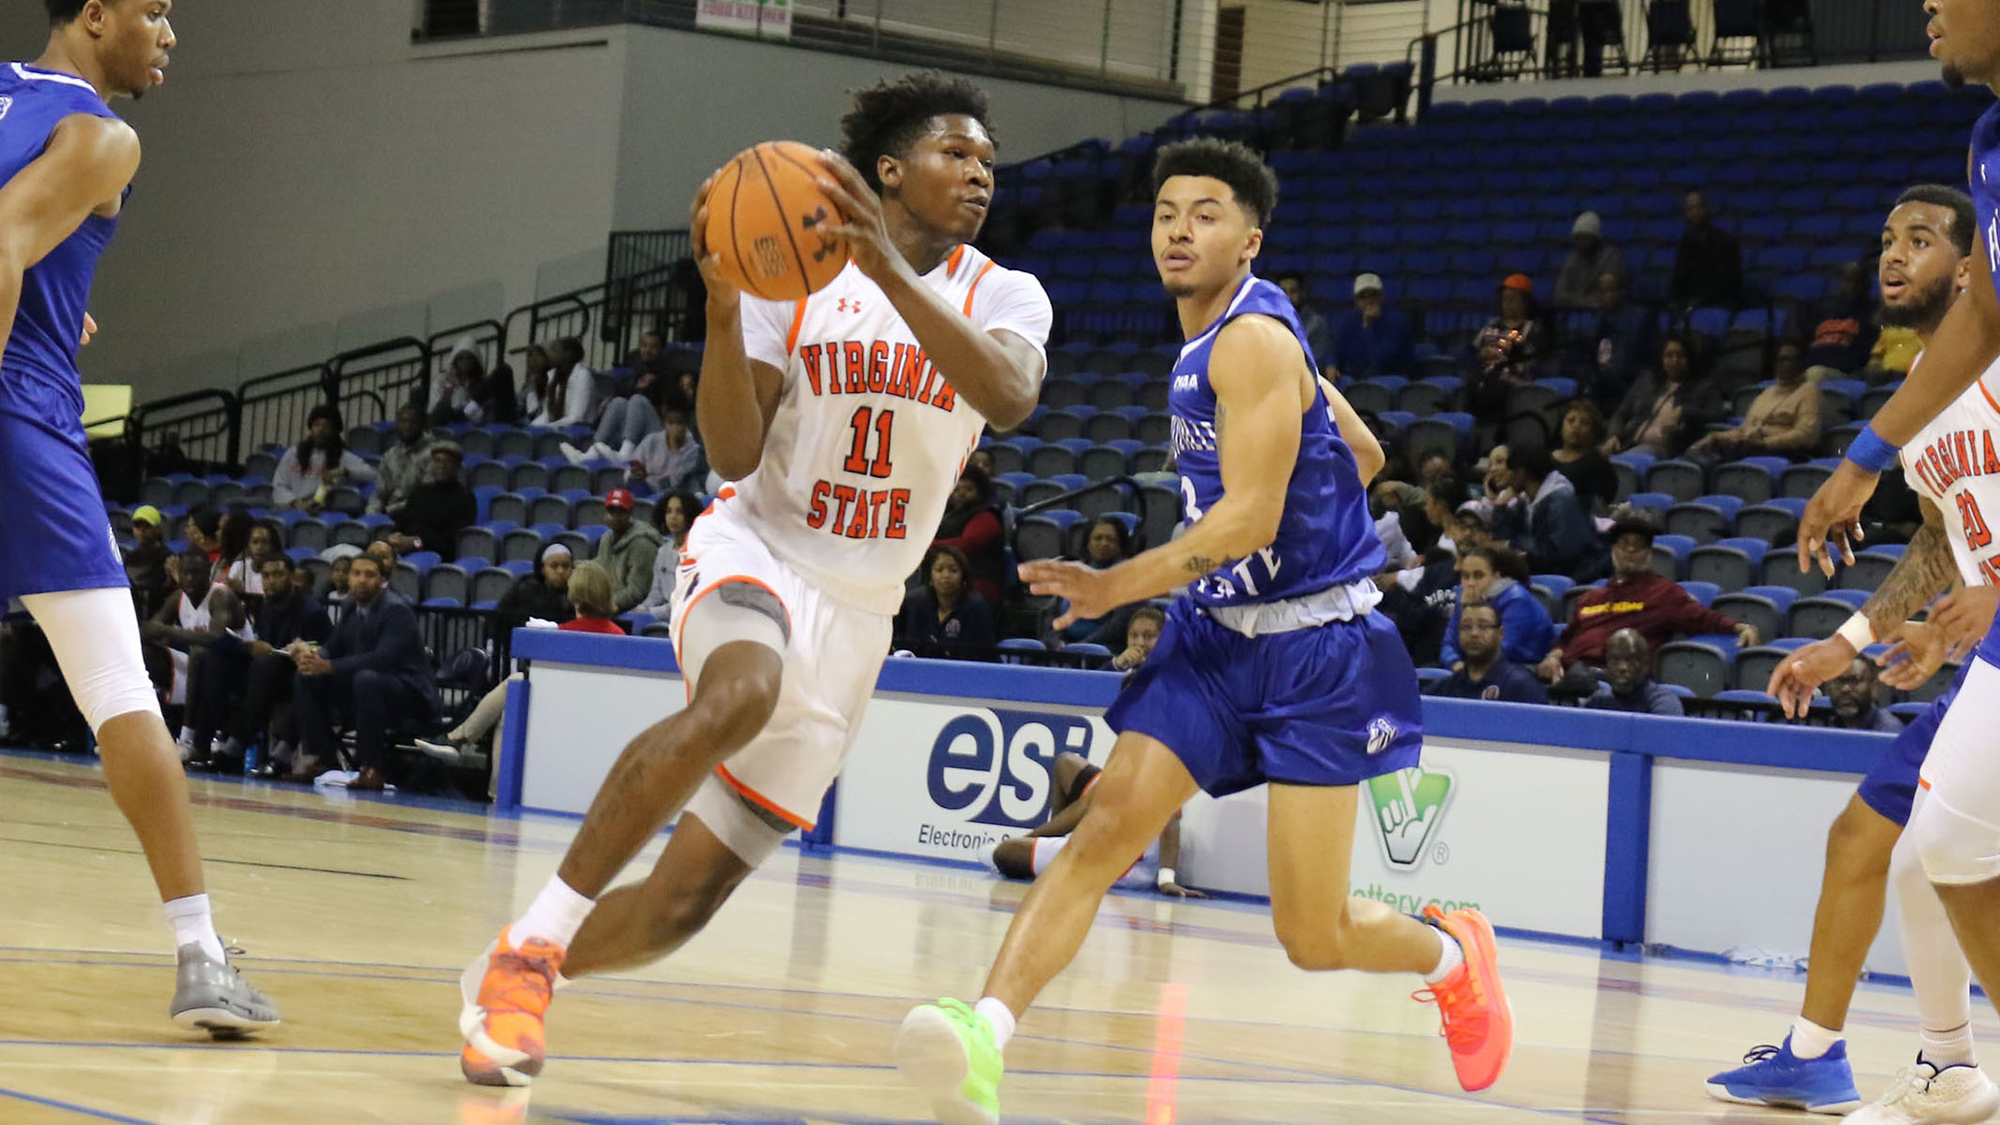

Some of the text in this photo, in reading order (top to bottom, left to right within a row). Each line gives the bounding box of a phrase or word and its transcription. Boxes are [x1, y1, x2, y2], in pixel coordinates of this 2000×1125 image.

[801, 340, 957, 412] VIRGINIA
[844, 406, 894, 478] 11
[1915, 430, 2000, 499] VIRGINIA
[807, 480, 910, 539] STATE
